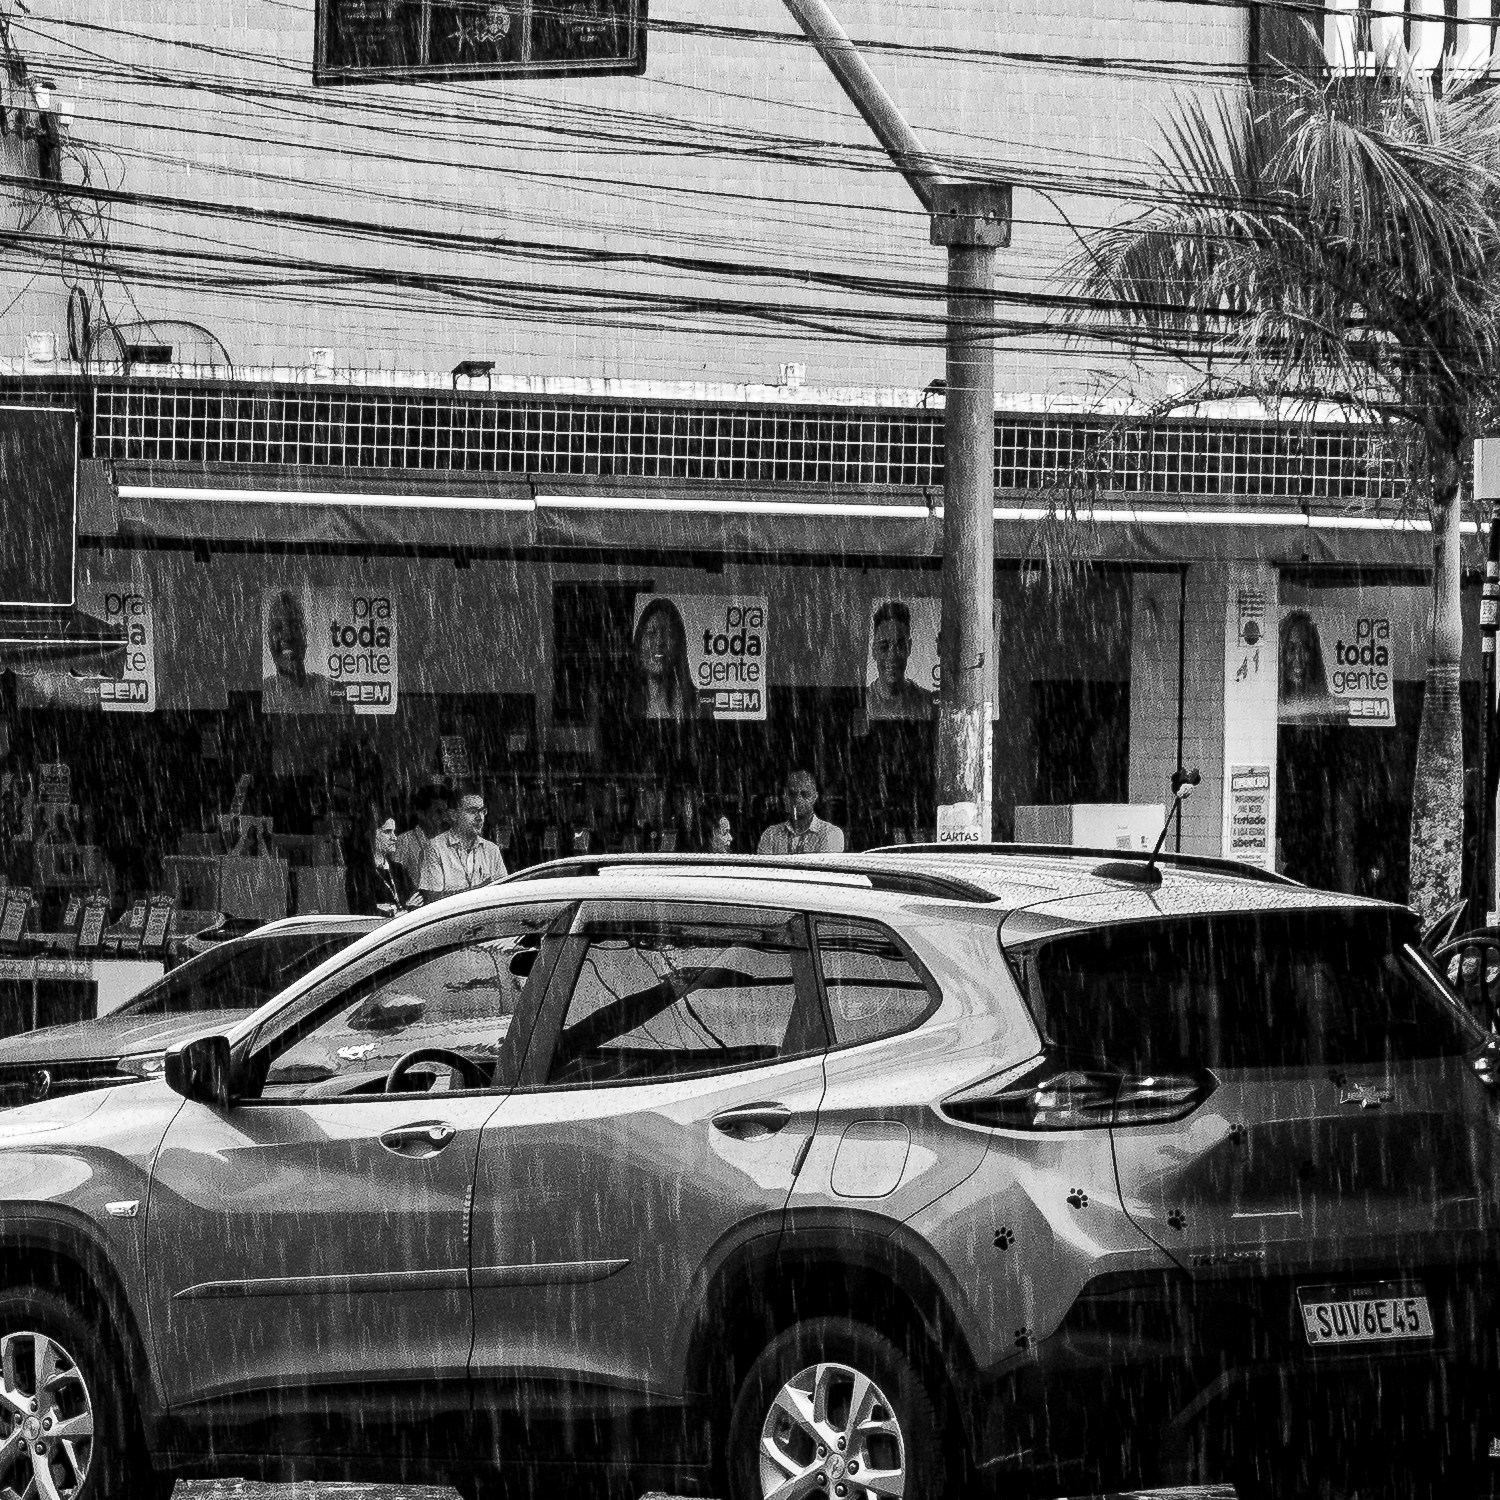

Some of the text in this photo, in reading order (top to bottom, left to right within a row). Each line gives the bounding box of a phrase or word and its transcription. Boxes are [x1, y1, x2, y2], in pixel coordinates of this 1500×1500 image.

[105, 593, 147, 624] pra
[353, 597, 391, 624] pra
[726, 606, 764, 634] pra
[330, 619, 391, 648] toda
[702, 628, 762, 657] toda
[1356, 618, 1390, 645] pra
[328, 649, 391, 679] gente
[1335, 639, 1389, 667] toda
[698, 657, 760, 686] gente
[1332, 667, 1388, 694] gente
[940, 831, 980, 843] CARTAS
[1315, 1300, 1420, 1338] SUV6E45
